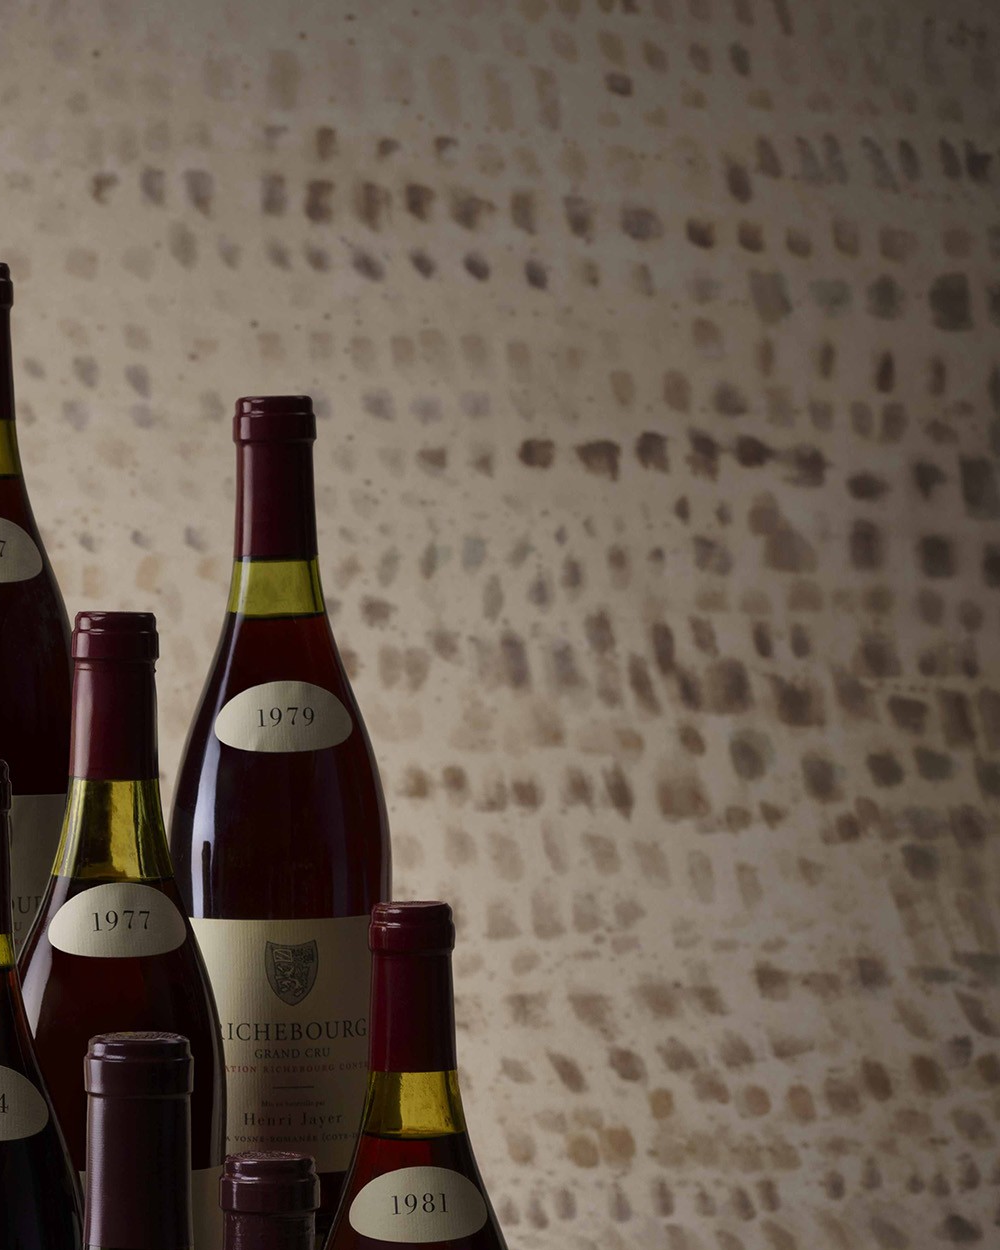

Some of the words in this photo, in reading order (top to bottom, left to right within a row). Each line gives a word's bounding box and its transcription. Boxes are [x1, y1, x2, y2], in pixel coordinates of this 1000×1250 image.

[257, 706, 315, 728] 1979
[92, 910, 150, 932] 1977
[254, 1048, 301, 1060] GRAND
[305, 1047, 331, 1059] CRU
[244, 1112, 292, 1126] Henri
[300, 1111, 343, 1129] Jayer
[391, 1192, 449, 1215] 1981
